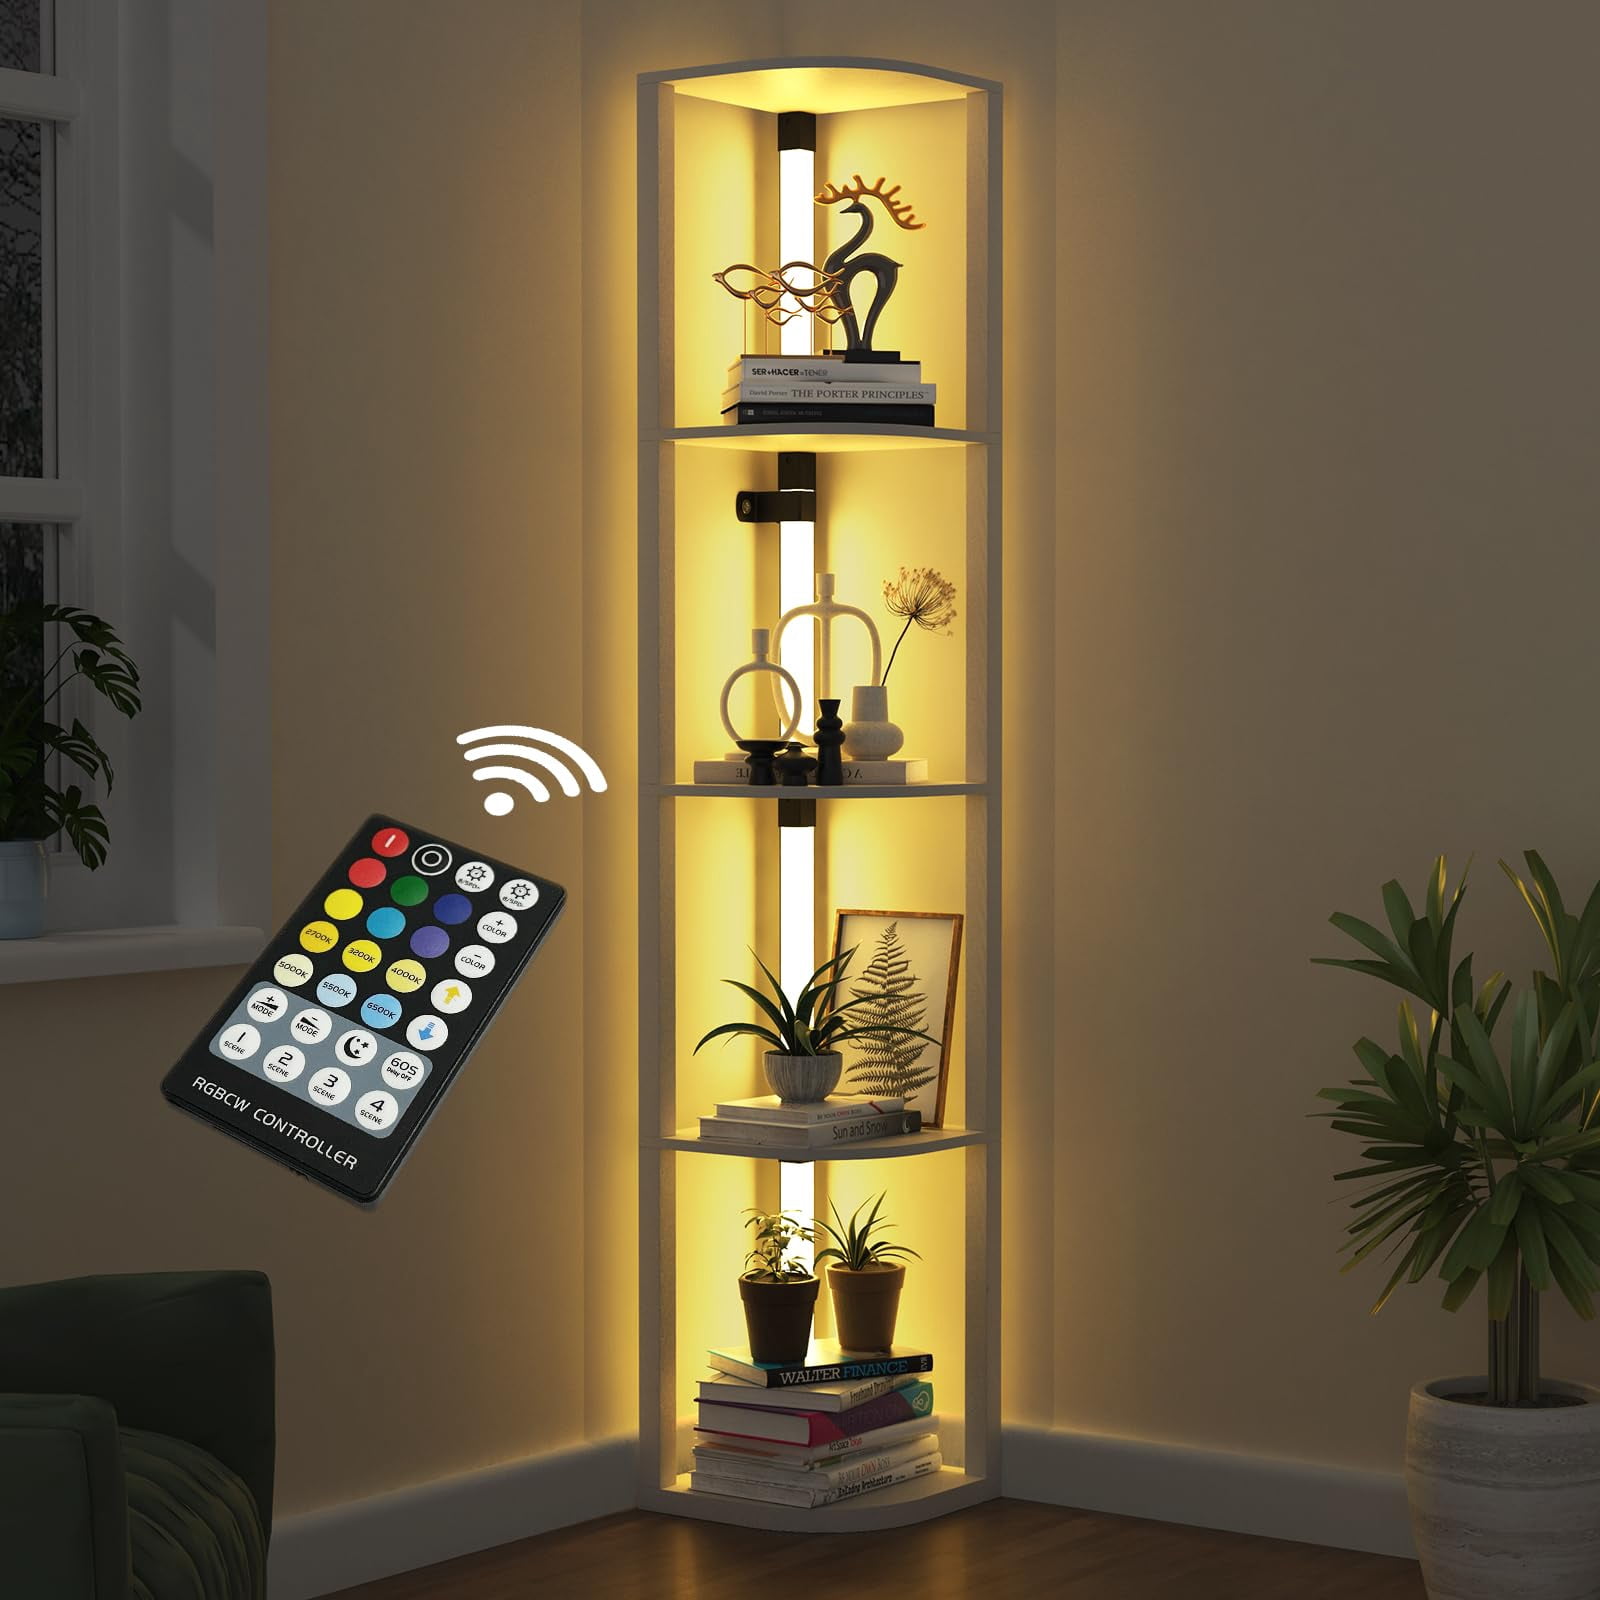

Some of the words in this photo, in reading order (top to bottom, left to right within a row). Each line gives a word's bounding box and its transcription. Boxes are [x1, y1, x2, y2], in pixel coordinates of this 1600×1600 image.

[791, 388, 814, 398] THE
[816, 389, 859, 399] PORTER
[305, 928, 333, 945] 2700K
[482, 924, 507, 938] COLOR
[347, 947, 376, 964] 3200K
[460, 956, 486, 970] COLOR
[278, 960, 309, 979] 5000K
[391, 967, 422, 985] 4000K
[322, 981, 352, 999] 5500K
[251, 1002, 275, 1018] MODE
[366, 1002, 397, 1020] 6500K
[295, 1022, 319, 1038] MODE
[223, 1040, 246, 1055] SCENE
[278, 1051, 294, 1067] 2
[267, 1063, 290, 1078] SCENE
[323, 1073, 339, 1088] 3
[312, 1085, 336, 1101] SCENE
[370, 1099, 385, 1113] 4
[192, 1076, 251, 1112] RGBCW
[253, 1108, 358, 1170] CONTROLLER
[359, 1109, 383, 1125] SCENE
[832, 1125, 848, 1140] Sun
[849, 1122, 865, 1137] and
[866, 1119, 888, 1135] Snow
[779, 1367, 841, 1385] WALTER
[843, 1360, 909, 1378] FINANCE
